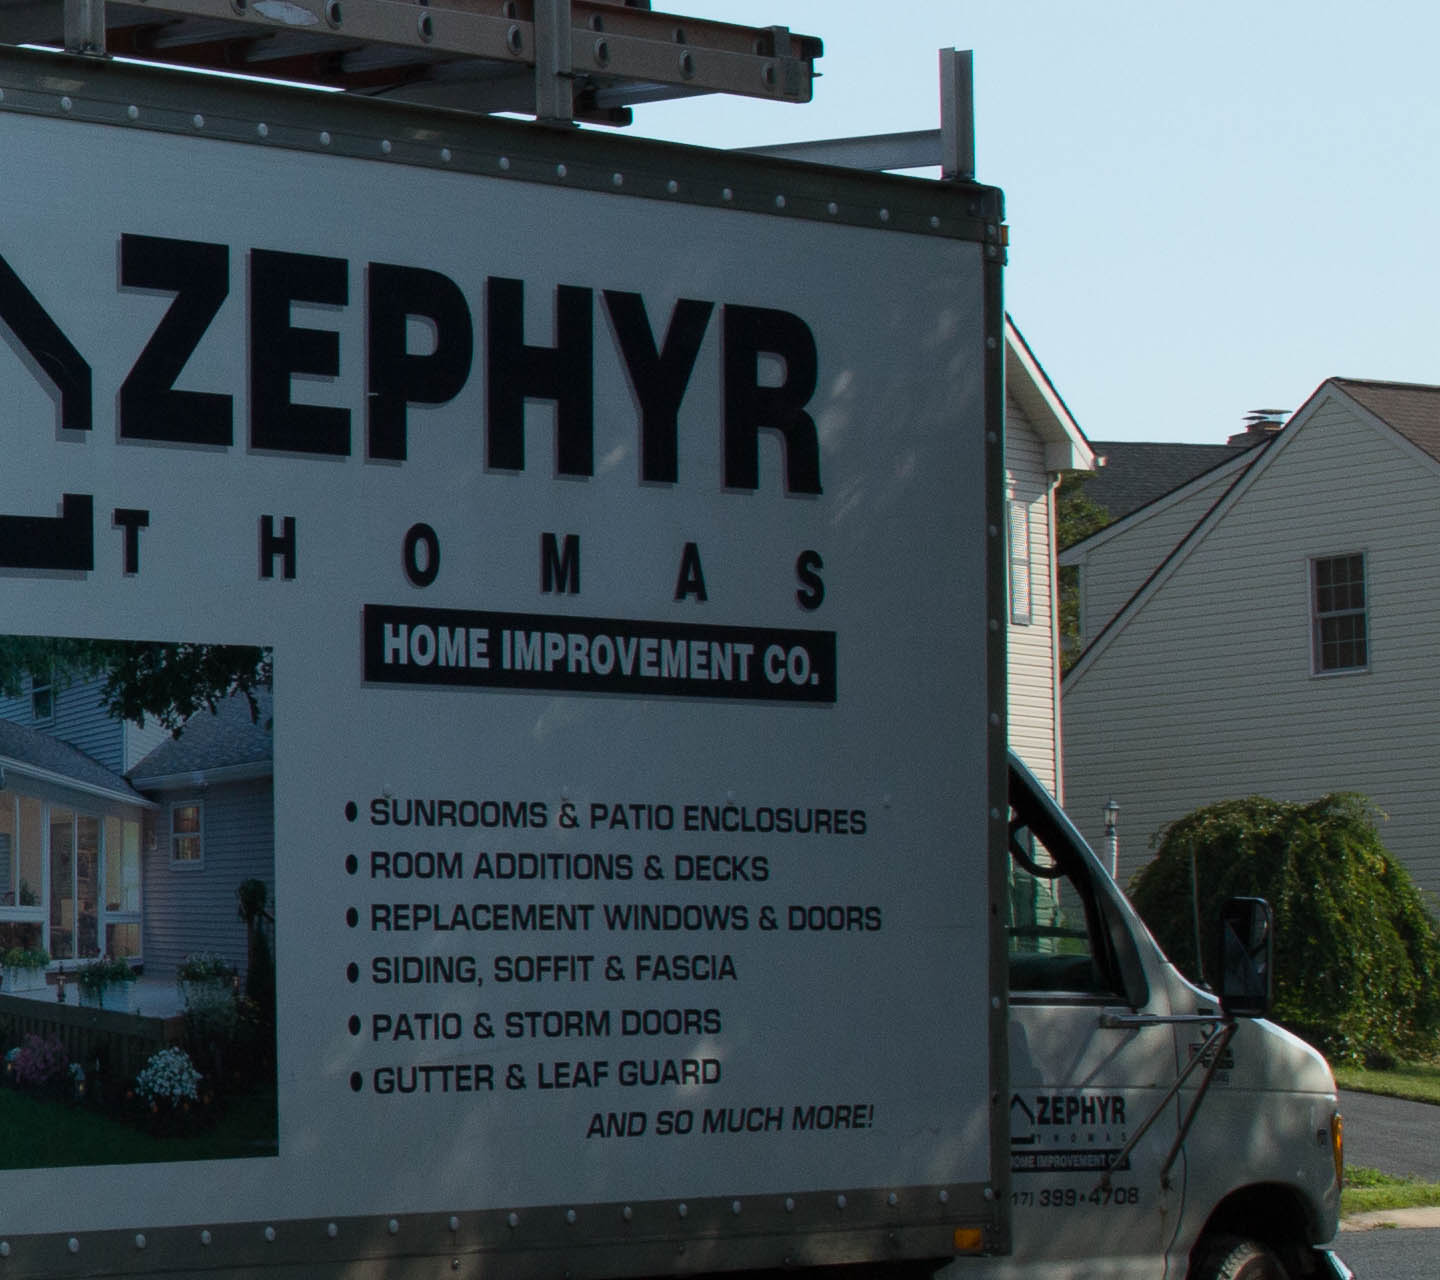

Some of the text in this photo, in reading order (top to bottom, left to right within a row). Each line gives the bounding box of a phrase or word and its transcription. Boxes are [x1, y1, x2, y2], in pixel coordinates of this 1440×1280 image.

[117, 232, 824, 495] ZEPHYR
[114, 509, 826, 610] THOMAS
[383, 622, 820, 686] HOME IMPROVEMENT CO.
[369, 798, 867, 835] SUNROOMS & PATIO ENCLOSURES
[370, 851, 769, 882] ROOM ADDITIONS & DECKS
[370, 904, 881, 931] REPLACEMENT WINDOWS & DOORS
[371, 955, 737, 987] SIDING, SOFFIT & FASCIA
[372, 1009, 721, 1041] PATIO & STORM DOORS
[373, 1059, 721, 1094] GUTTER & LEAF GUARD
[587, 1104, 874, 1139] AND SO MUCH MORE!
[1036, 1095, 1125, 1124] ZEPHYR
[1037, 1153, 1106, 1168] IMPROVEMENT
